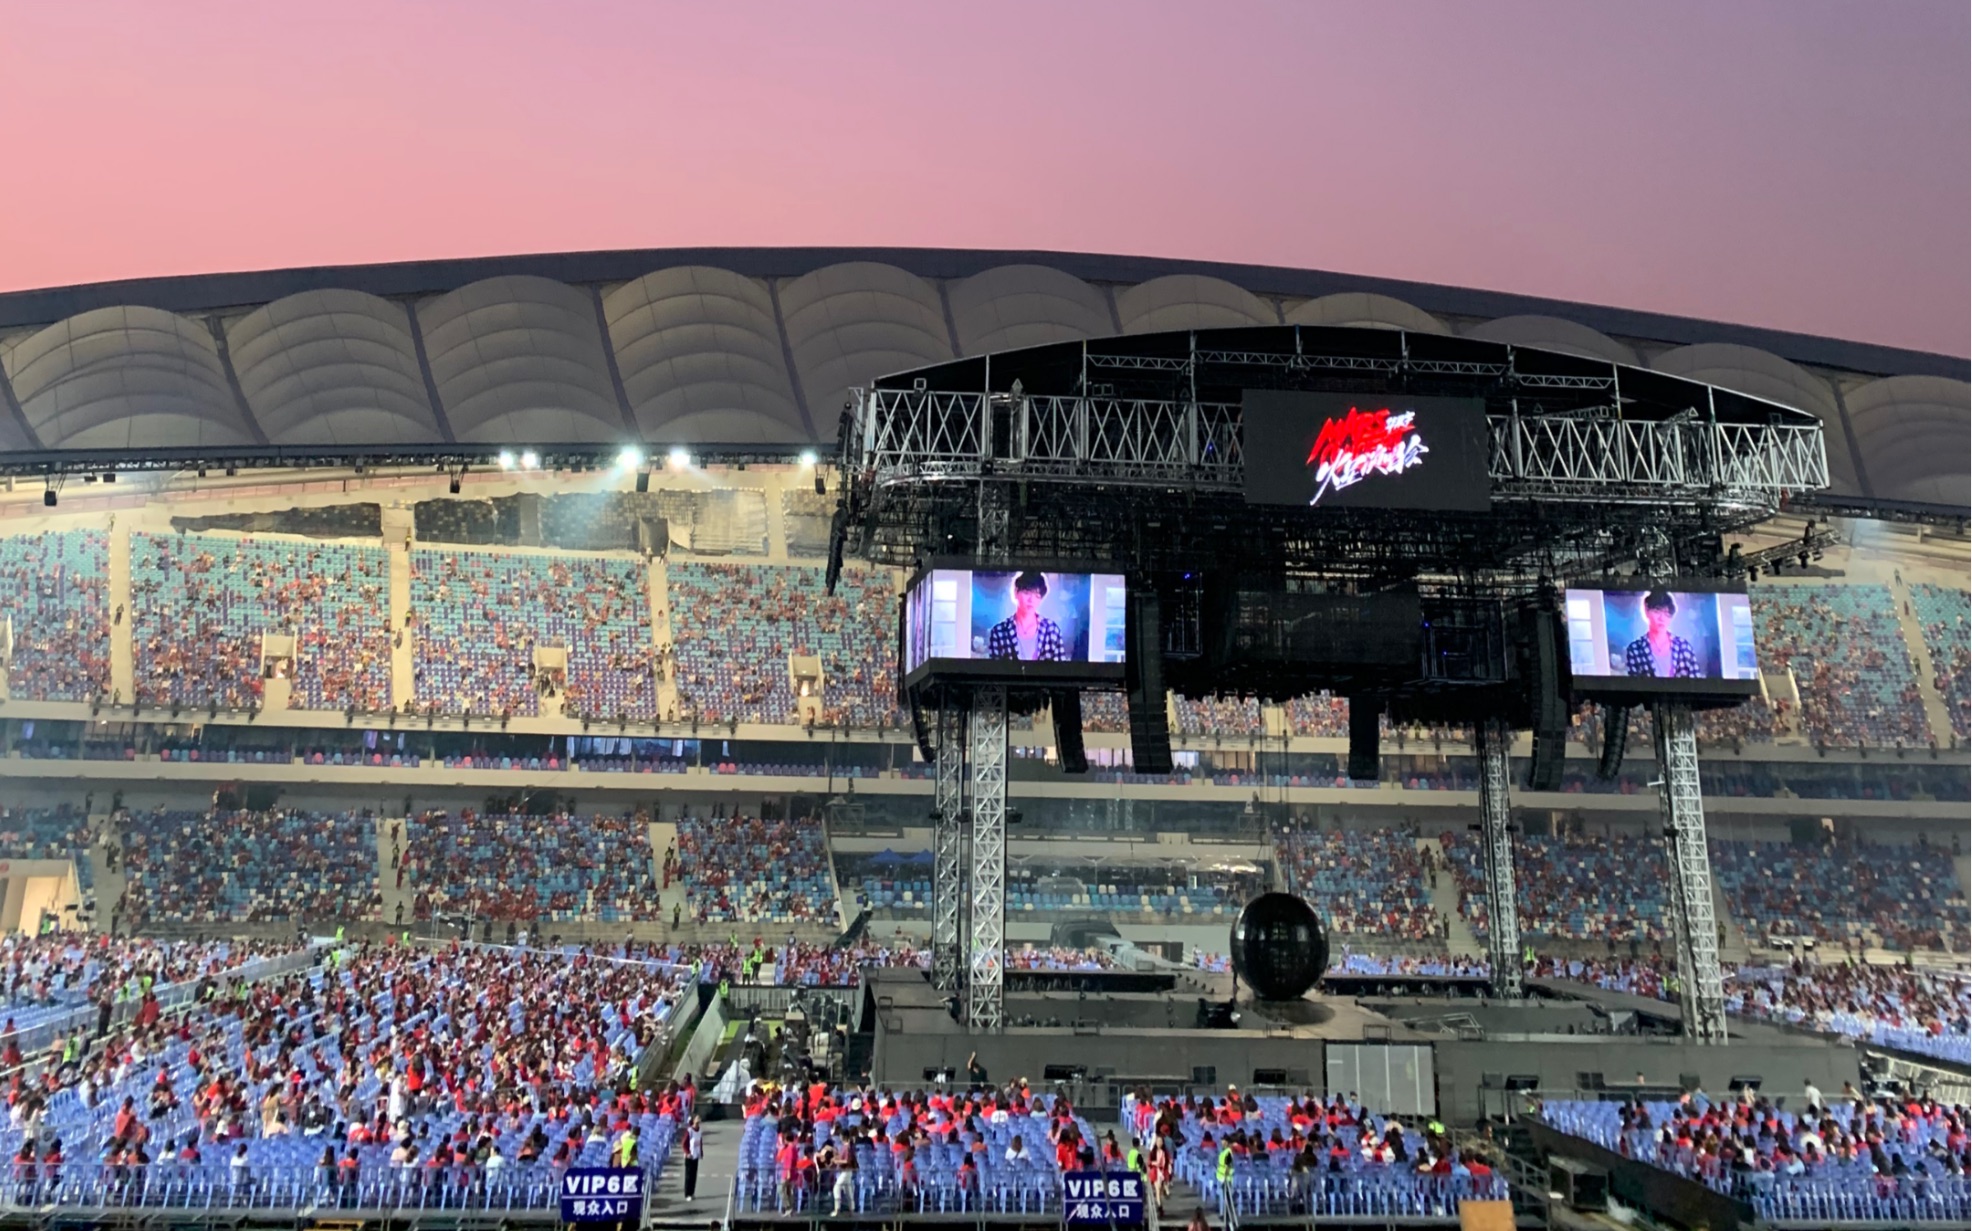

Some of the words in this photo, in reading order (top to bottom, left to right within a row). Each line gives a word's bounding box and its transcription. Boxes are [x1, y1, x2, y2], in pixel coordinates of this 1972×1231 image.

[566, 1175, 639, 1194] VIP6区
[1068, 1179, 1138, 1197] VIP6区
[573, 1200, 628, 1216] 观众入口
